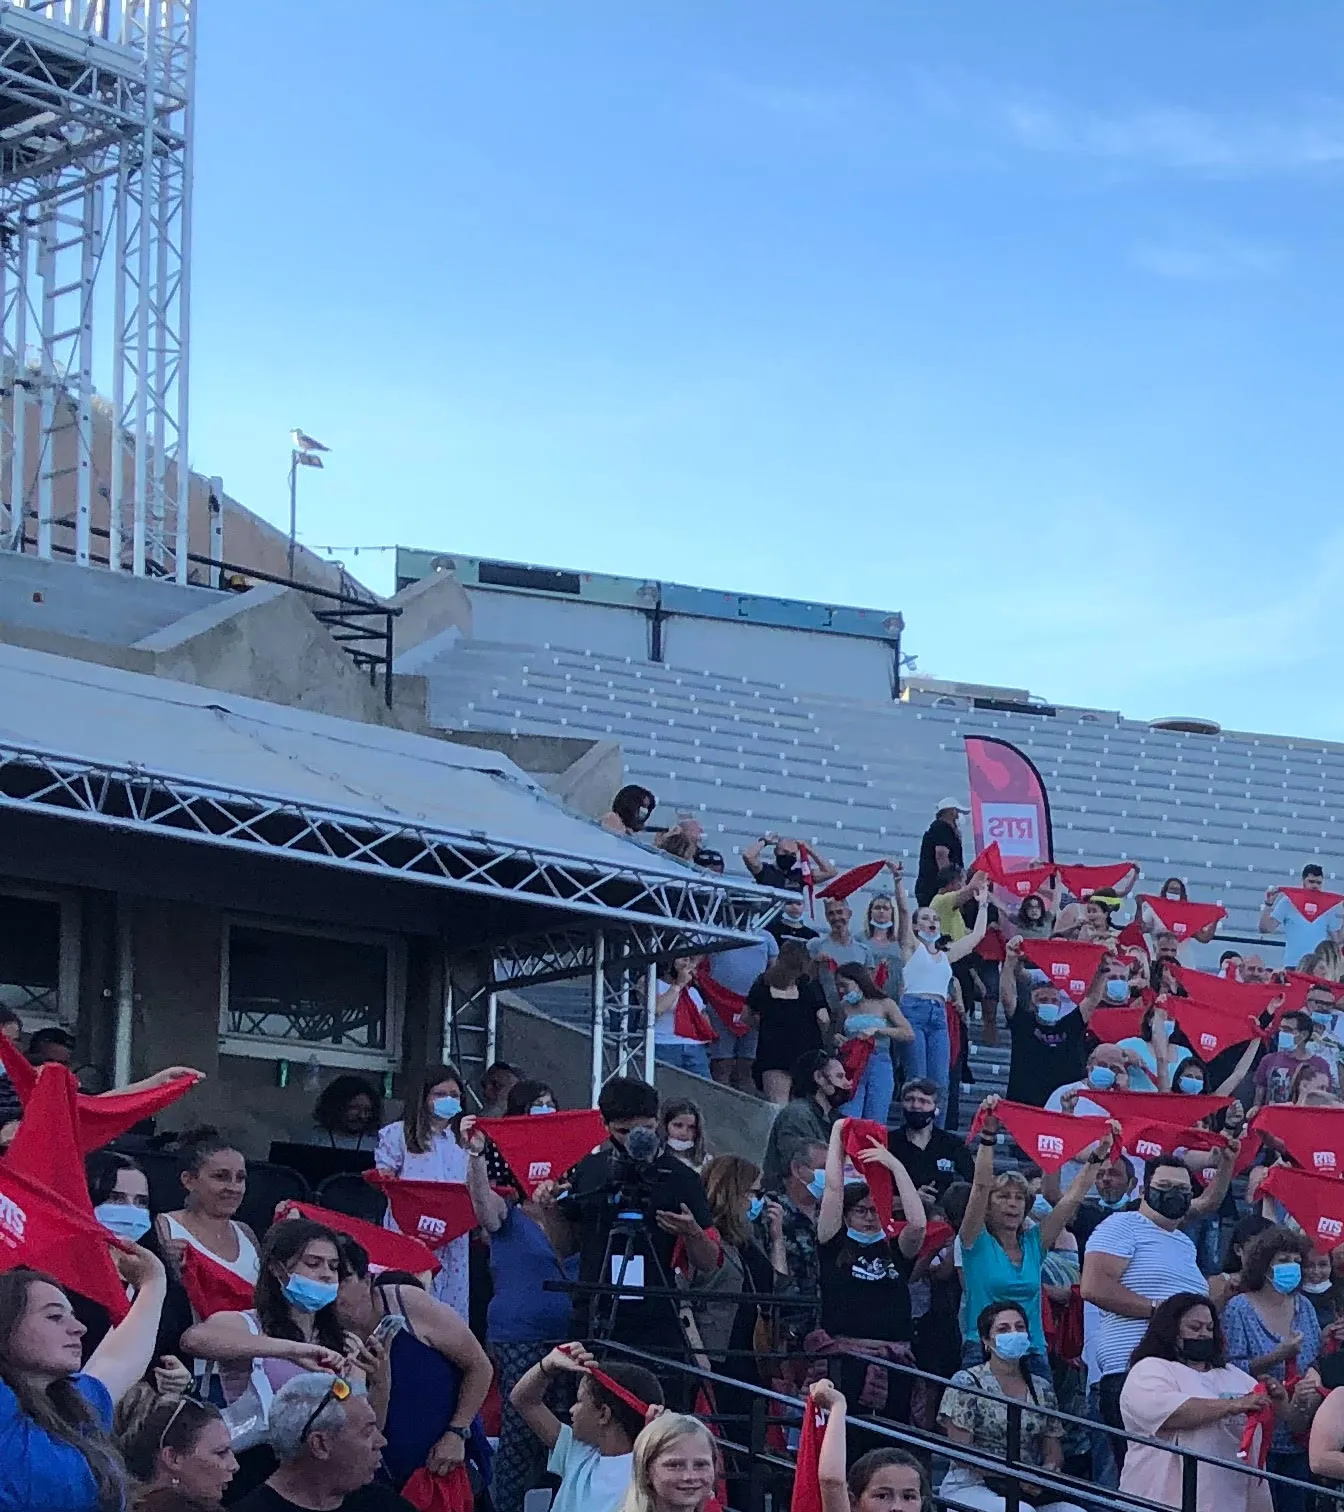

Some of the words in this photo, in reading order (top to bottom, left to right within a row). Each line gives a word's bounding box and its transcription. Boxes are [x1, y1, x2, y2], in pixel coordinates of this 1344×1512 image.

[1038, 1134, 1064, 1152] RTS
[1136, 1139, 1162, 1156] RTS
[1313, 1151, 1337, 1165] RTS
[528, 1162, 552, 1178] RTS
[415, 1215, 448, 1234] RTS
[1317, 1216, 1344, 1232] RTS
